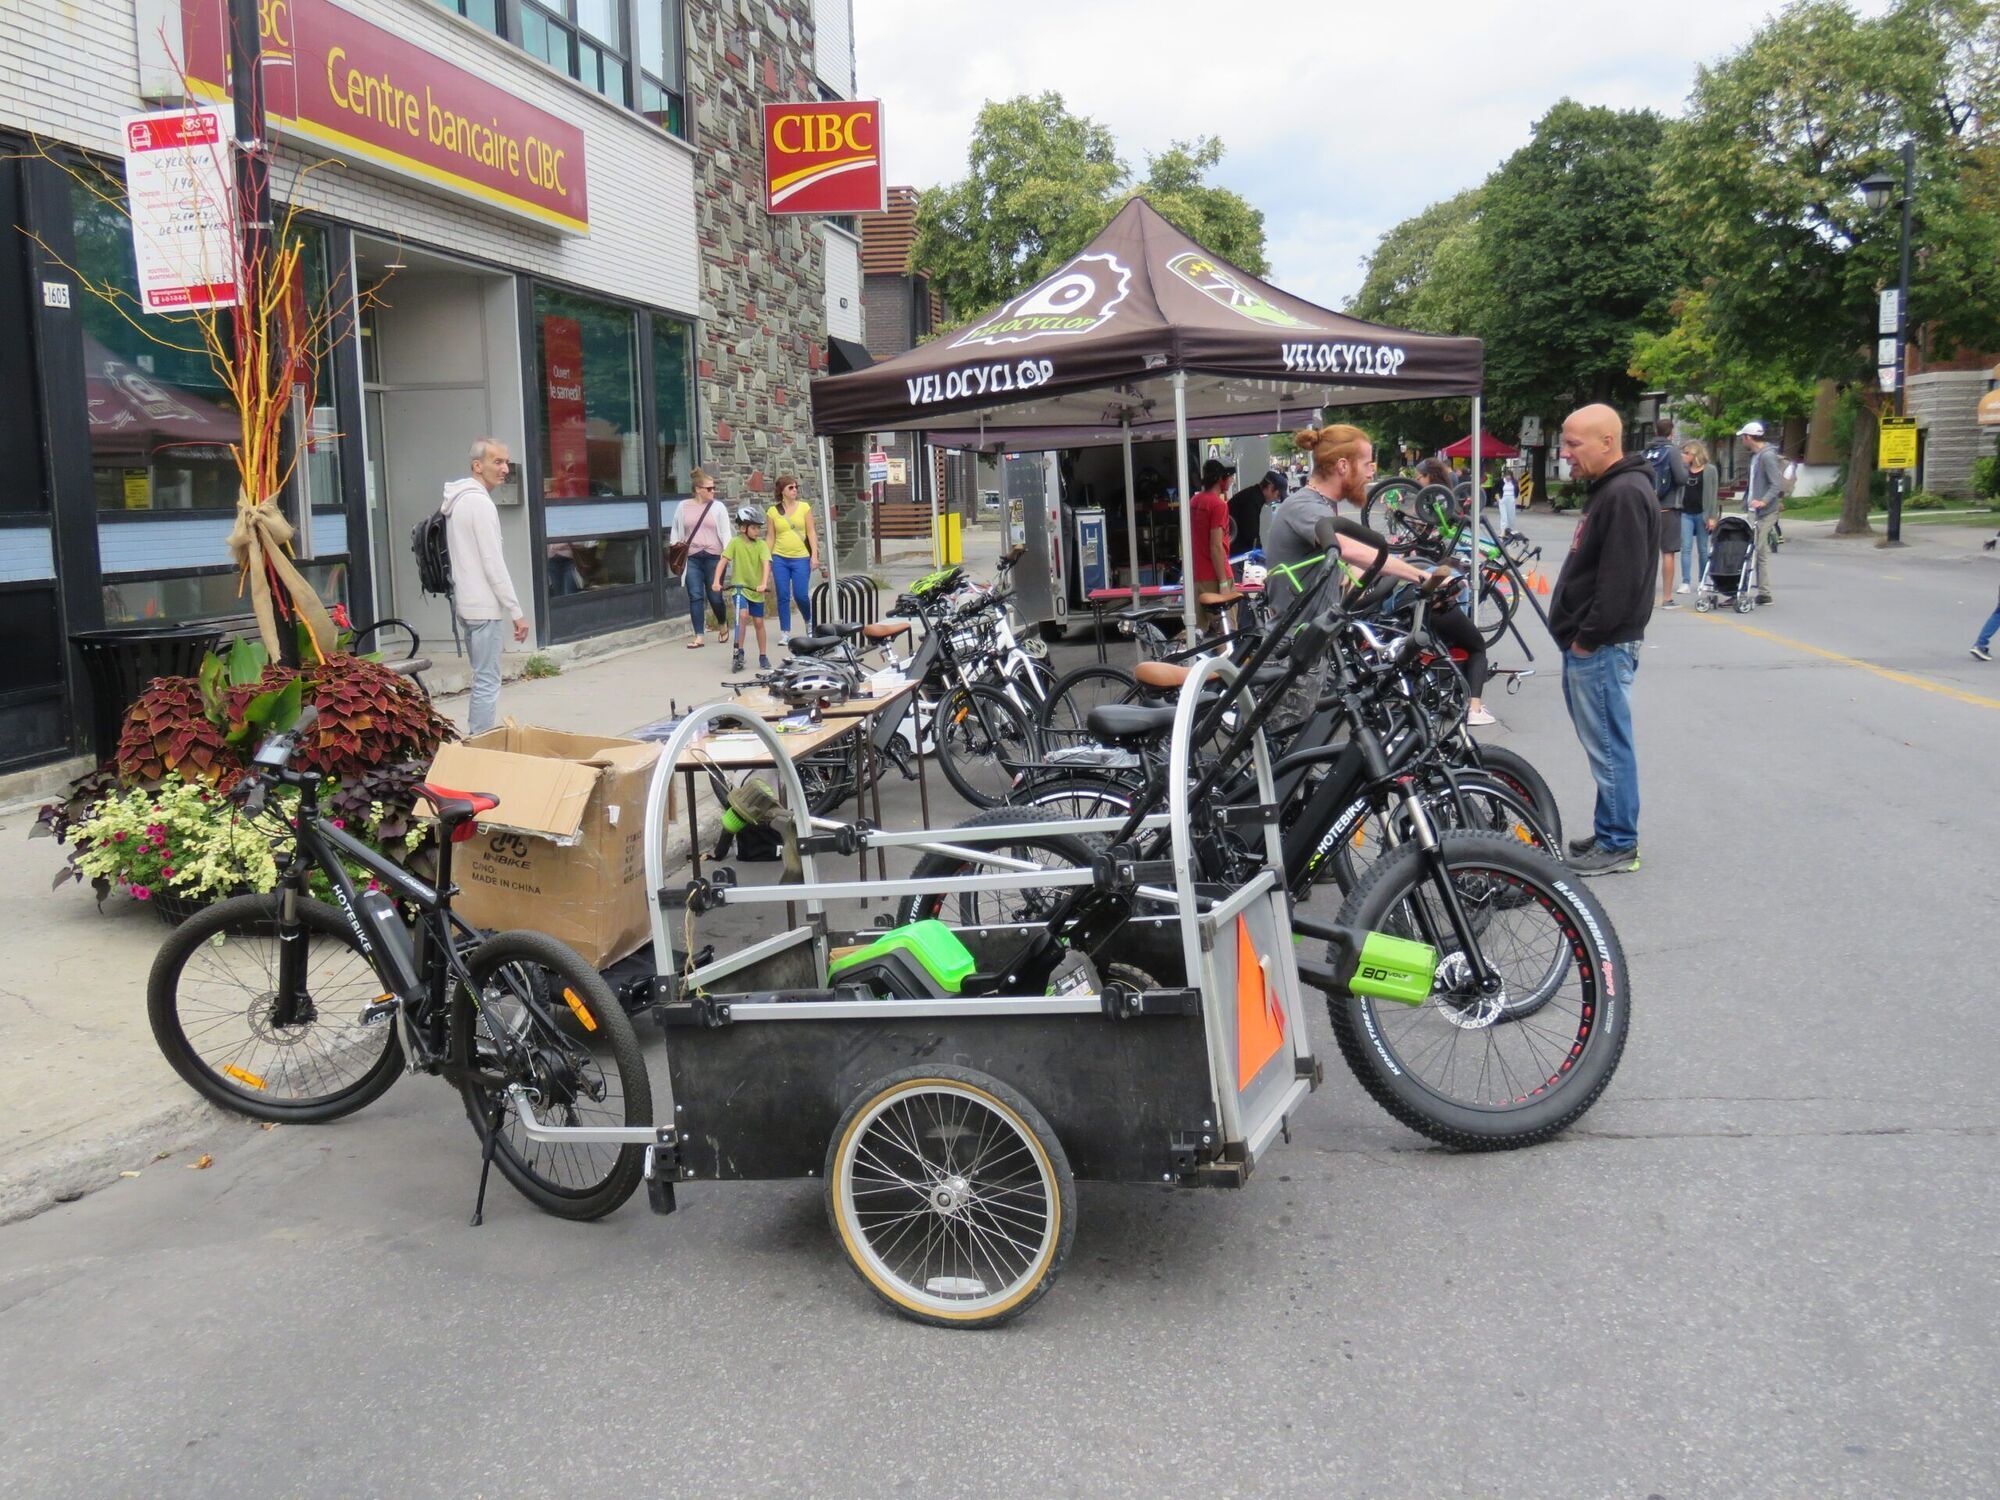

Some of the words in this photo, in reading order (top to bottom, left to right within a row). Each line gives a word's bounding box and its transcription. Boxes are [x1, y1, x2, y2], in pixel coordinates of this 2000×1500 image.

[327, 46, 420, 137] Centre
[425, 85, 520, 177] bancaire
[525, 136, 567, 196] CIBC
[773, 112, 872, 154] CIBC
[47, 286, 68, 304] 1605
[967, 317, 1097, 340] VELOCYCLOP
[1281, 344, 1405, 375] VELOCYCLOP
[906, 360, 1054, 406] VELOCYCLOP
[1317, 798, 1366, 854] HOTEBIKE
[472, 872, 497, 886] MADE
[500, 879, 510, 888] IN
[511, 882, 541, 895] CHINA
[332, 884, 373, 952] HOTEBIKE
[1361, 967, 1388, 981] 80
